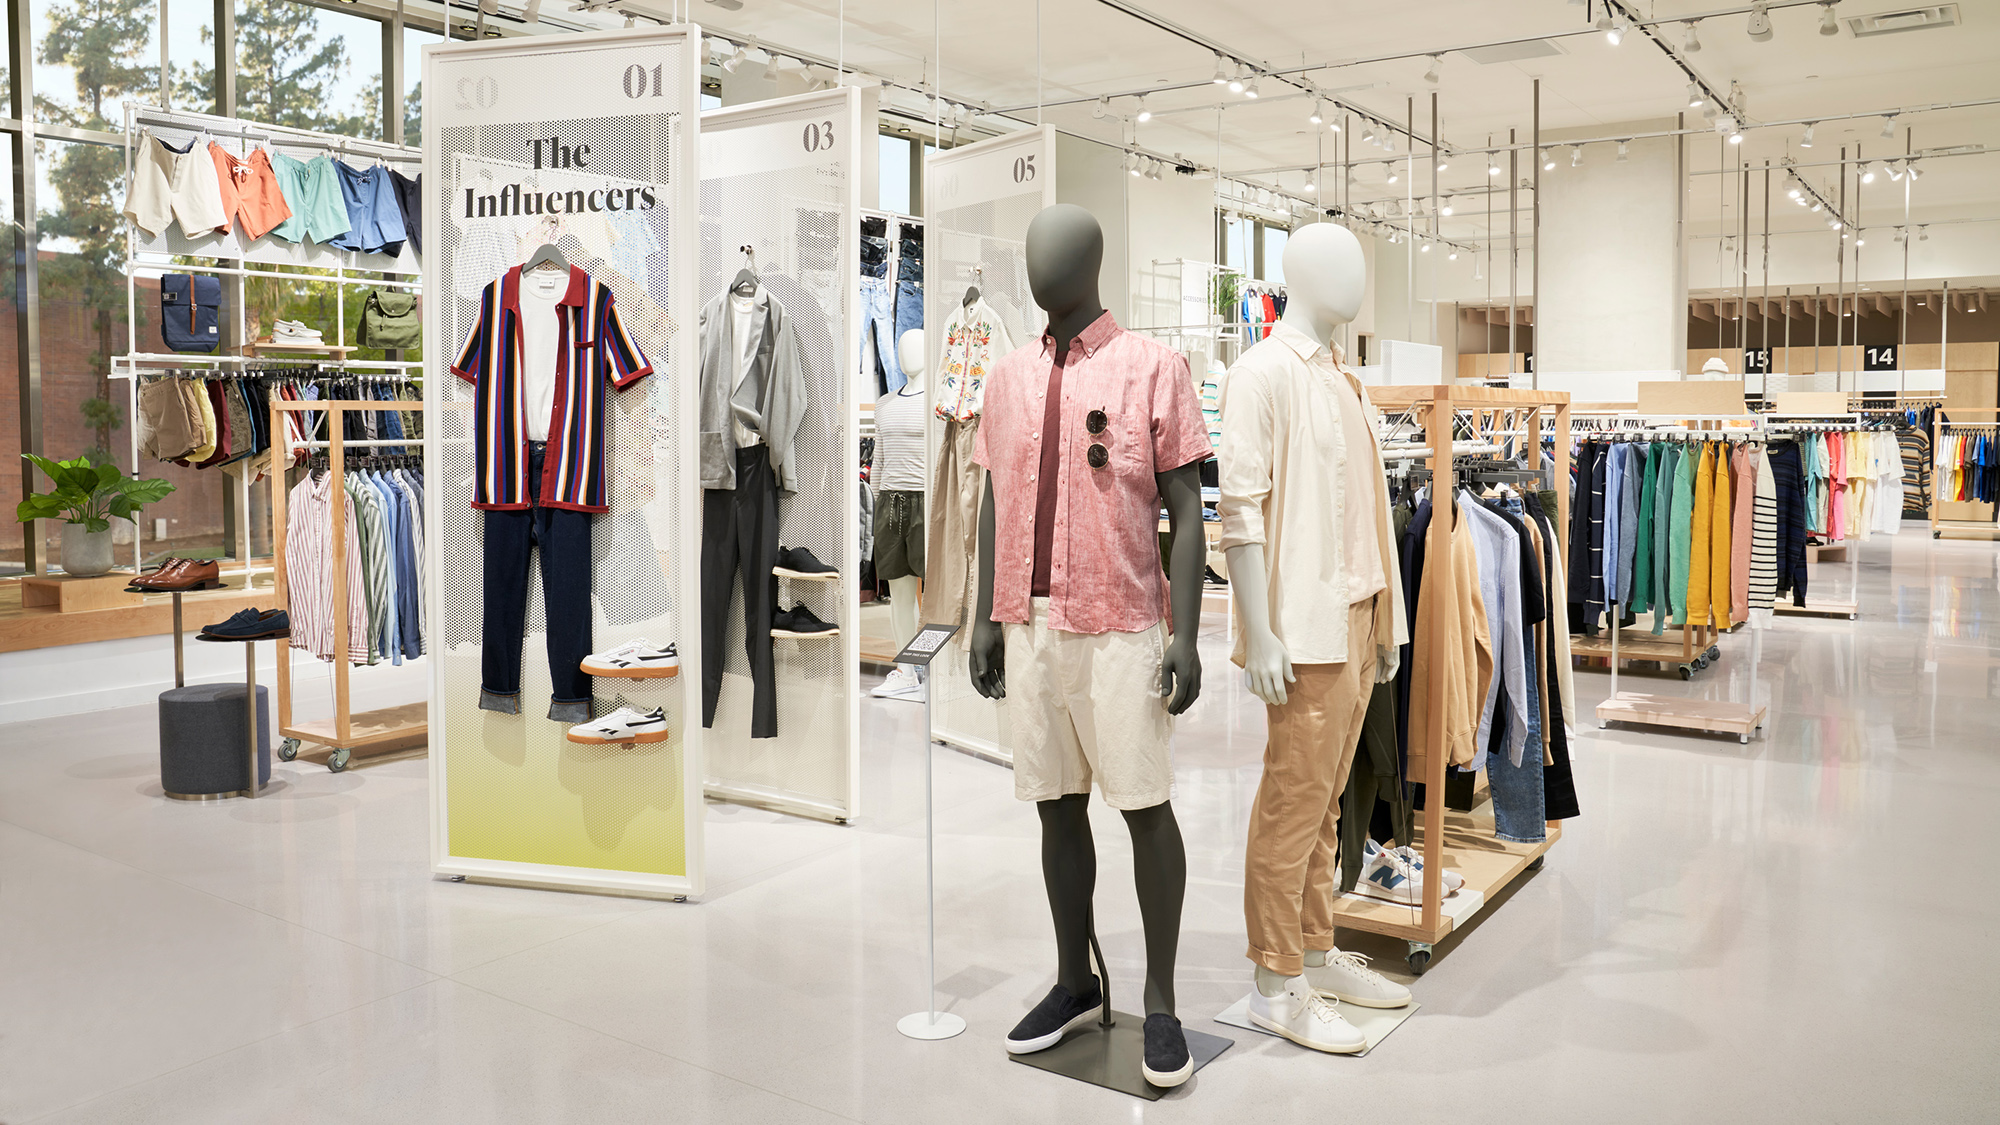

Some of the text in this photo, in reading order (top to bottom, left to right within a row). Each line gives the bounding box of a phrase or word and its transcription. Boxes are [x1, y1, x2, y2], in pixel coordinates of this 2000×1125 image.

[622, 62, 664, 99] 01
[526, 136, 591, 169] The
[802, 120, 834, 153] 03
[1013, 154, 1036, 184] 05
[464, 183, 656, 218] Influencers
[1745, 350, 1770, 368] 15
[1867, 347, 1894, 365] 14
